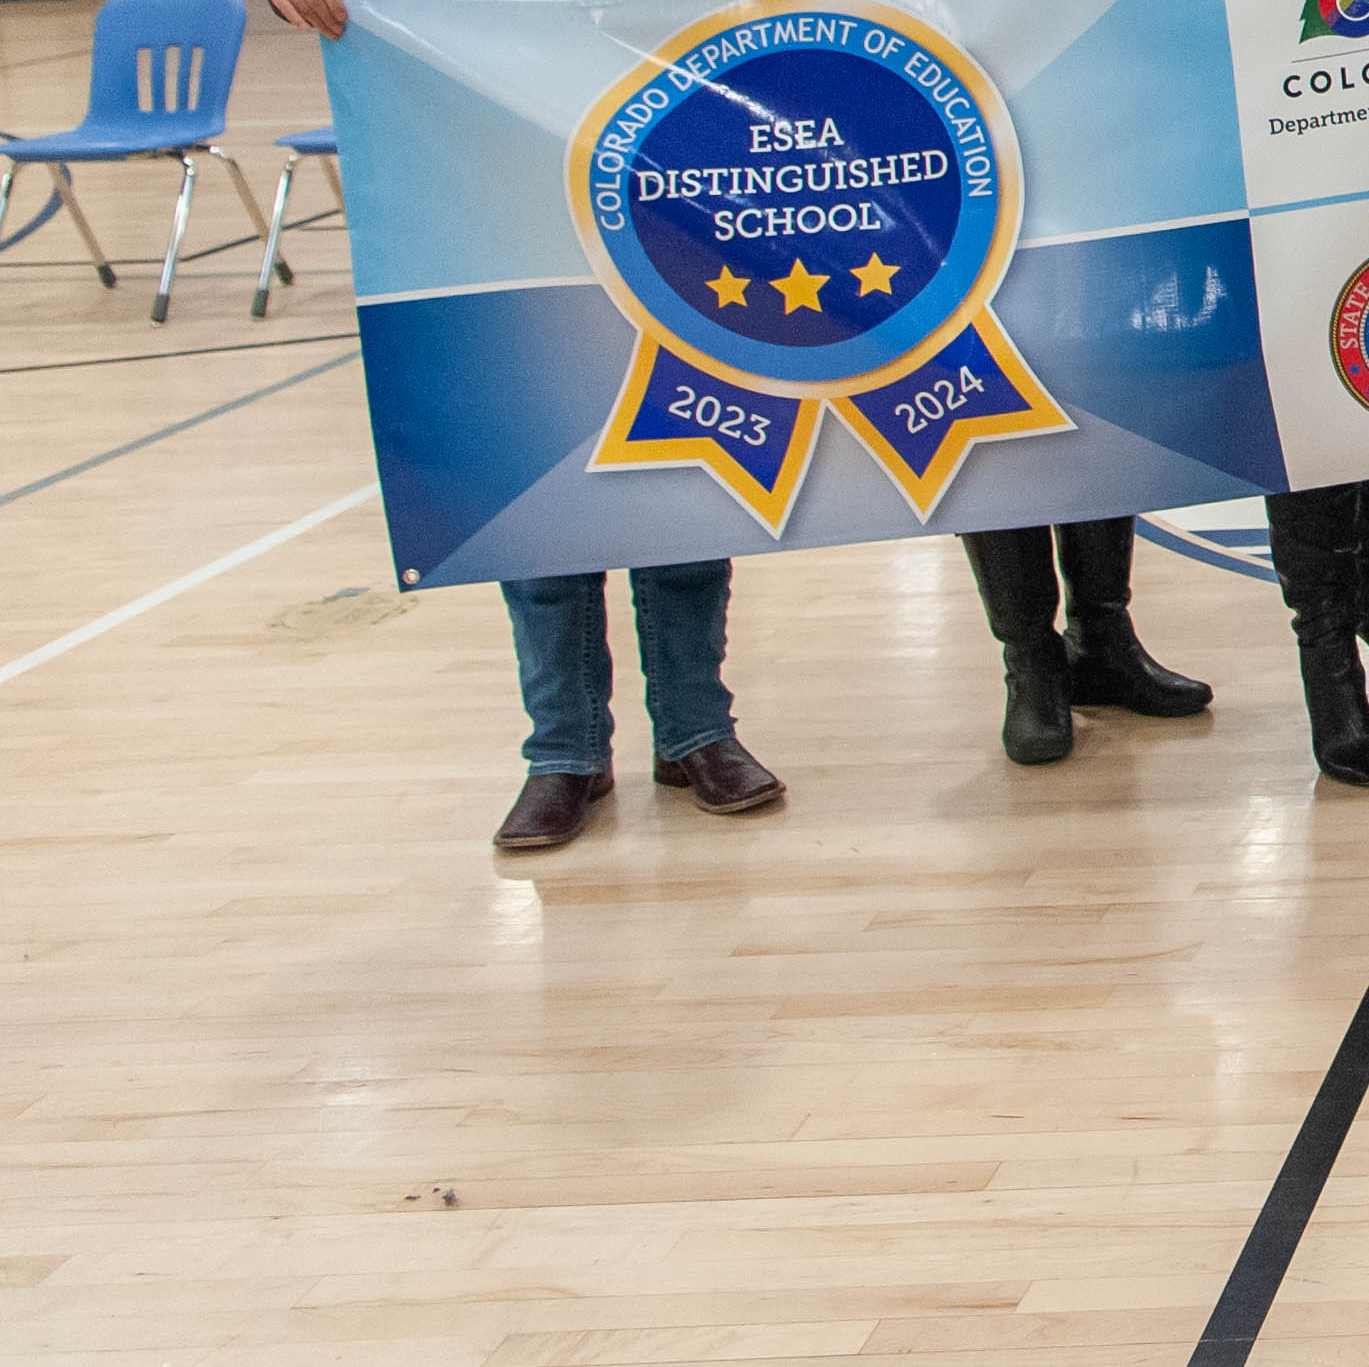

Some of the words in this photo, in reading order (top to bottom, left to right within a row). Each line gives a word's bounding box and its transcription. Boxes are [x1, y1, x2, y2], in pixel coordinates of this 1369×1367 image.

[595, 87, 670, 233] COLORADO
[667, 17, 859, 93] DEPARTMENT
[863, 29, 906, 60] OF
[902, 50, 994, 198] EDUCATION
[749, 117, 845, 155] ESEA
[637, 149, 950, 203] DISTINGUISHED
[713, 201, 883, 243] SCHOOL
[667, 385, 771, 447] 2023
[893, 364, 986, 435] 2024
